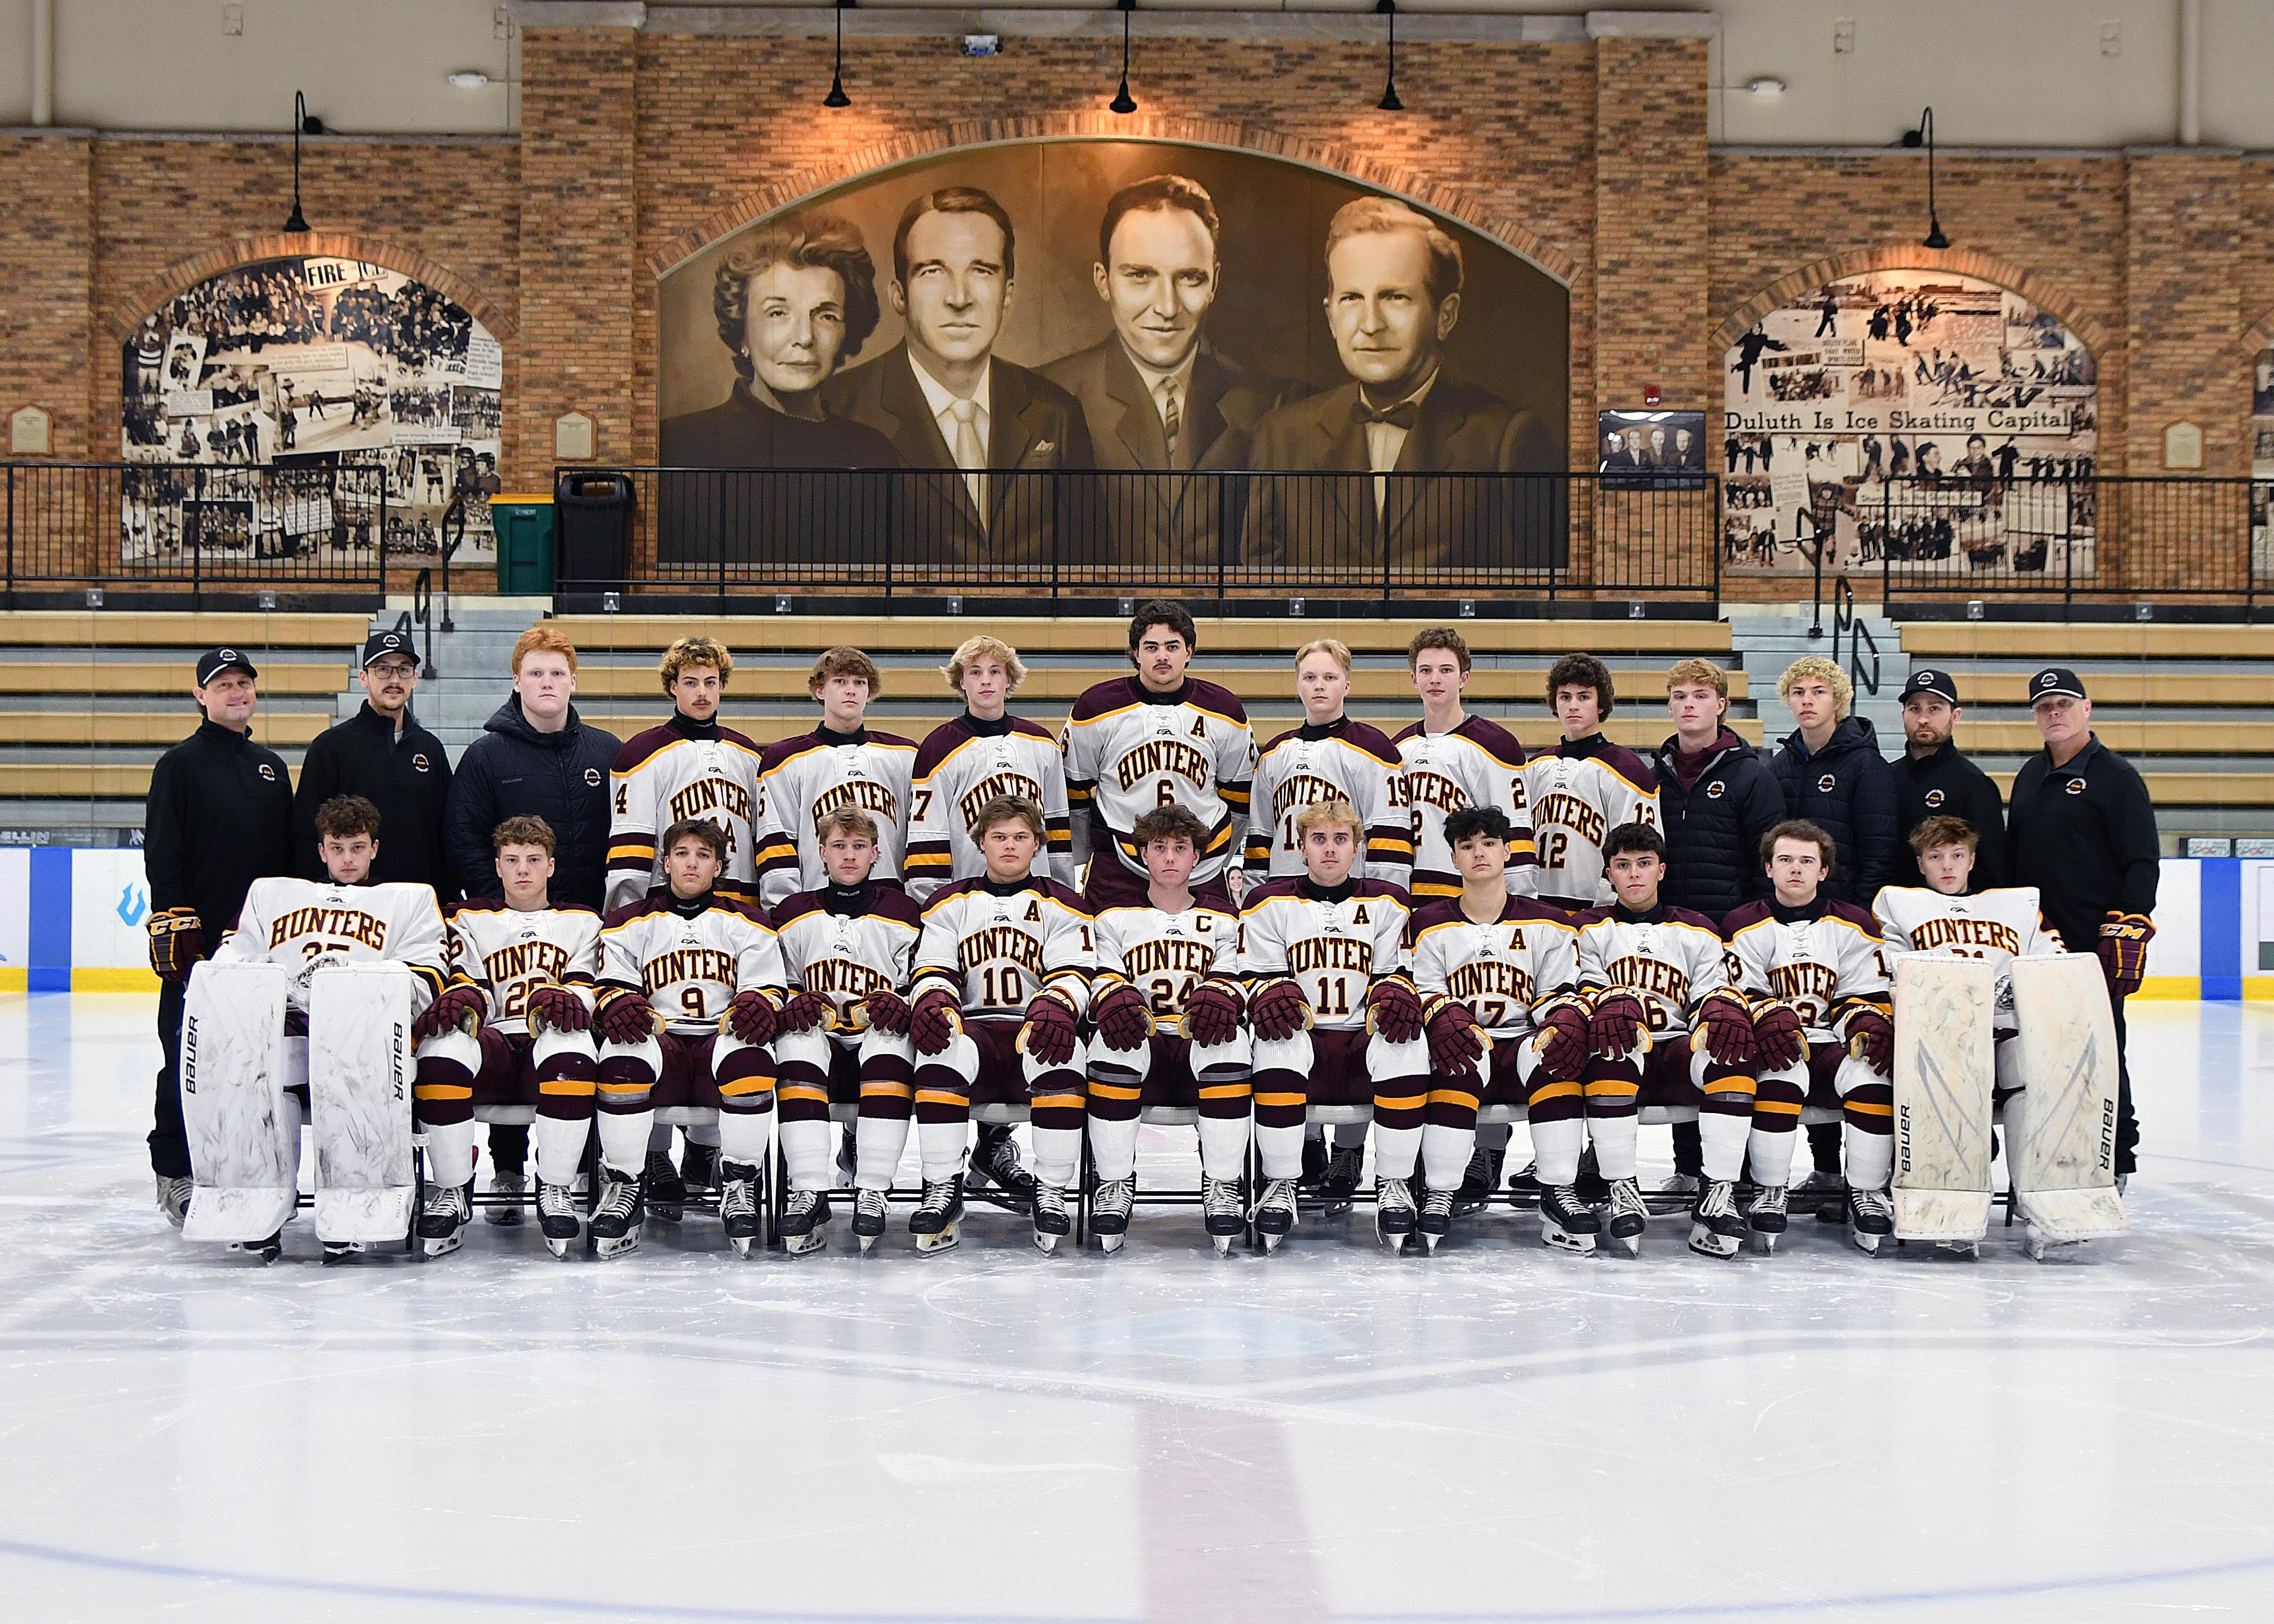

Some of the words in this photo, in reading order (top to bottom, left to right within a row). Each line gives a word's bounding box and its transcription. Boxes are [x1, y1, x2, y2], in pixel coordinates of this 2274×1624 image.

[307, 263, 347, 287] FIRE
[1726, 412, 1802, 430] Duluth
[1814, 413, 1834, 429] Is
[1846, 412, 1877, 429] Ice
[1889, 411, 1975, 432] Skating
[1987, 410, 2071, 431] Capital
[1190, 715, 1206, 738] A
[1118, 740, 1209, 793] HUNTERS
[615, 783, 629, 815] 4
[908, 790, 933, 822] 7
[1510, 777, 1528, 811] 2
[1538, 831, 1568, 870] 12
[1024, 900, 1041, 923] A
[1196, 916, 1212, 934] C
[1353, 904, 1370, 925] A
[269, 907, 387, 951] HUNTERS
[1509, 927, 1527, 951] A
[1909, 918, 2019, 956] HUNTERS
[2099, 923, 2146, 939] CM
[959, 926, 1043, 980] HUNTER
[681, 987, 706, 1018] 9
[982, 966, 1023, 1007] 10
[1316, 977, 1350, 1016] 11
